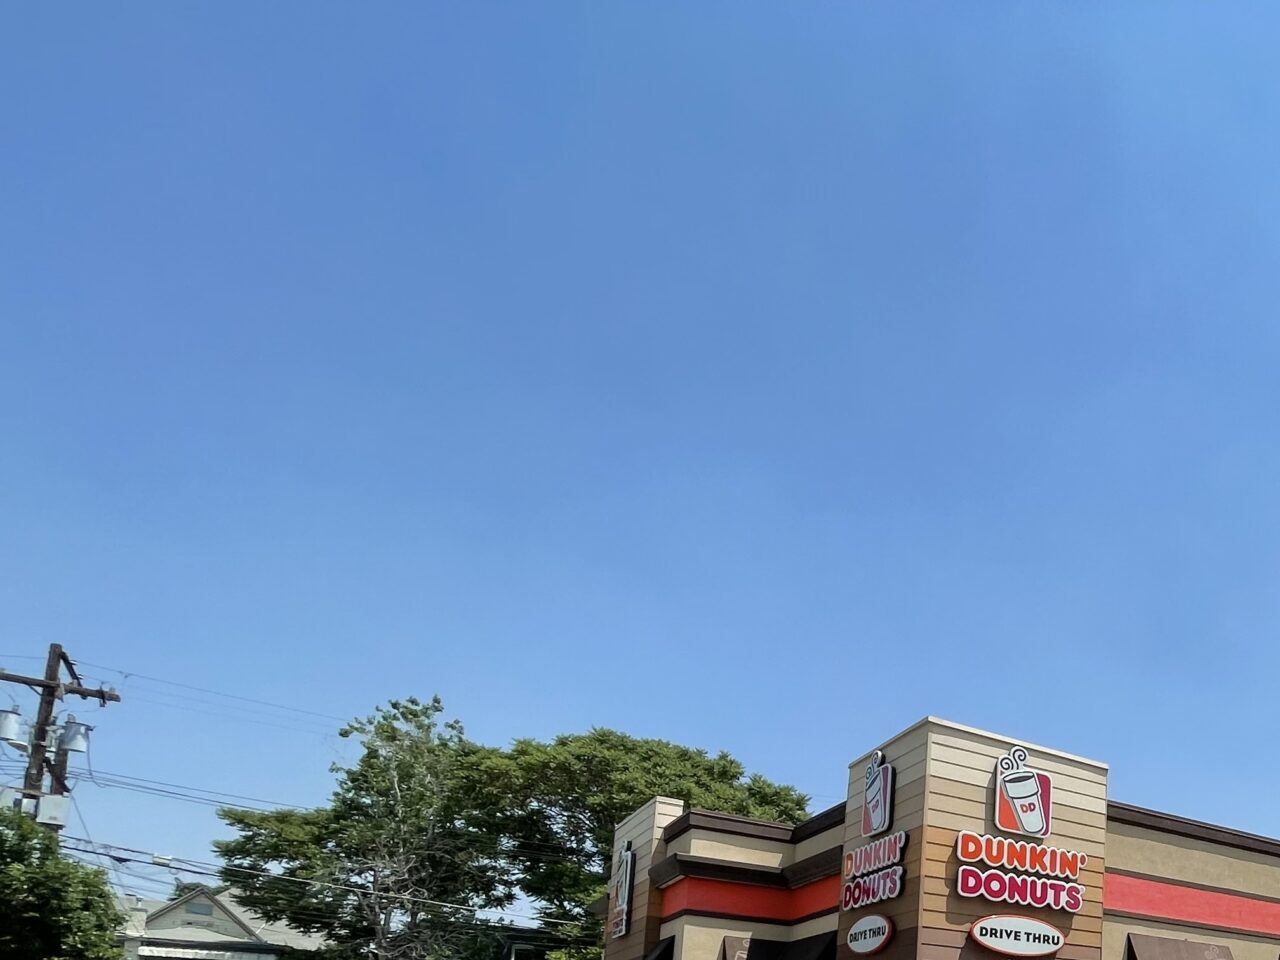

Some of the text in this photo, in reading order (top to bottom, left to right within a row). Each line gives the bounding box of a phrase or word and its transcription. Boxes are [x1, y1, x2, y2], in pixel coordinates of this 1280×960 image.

[1020, 802, 1036, 814] DD
[844, 833, 904, 877] DUNKIN'
[960, 833, 1087, 877] DUNKIN'
[843, 871, 899, 909] DONUTS
[960, 867, 1083, 911] DONUTS
[849, 924, 887, 943] DRIVE THRU
[979, 926, 1060, 946] DRIVE THRU
